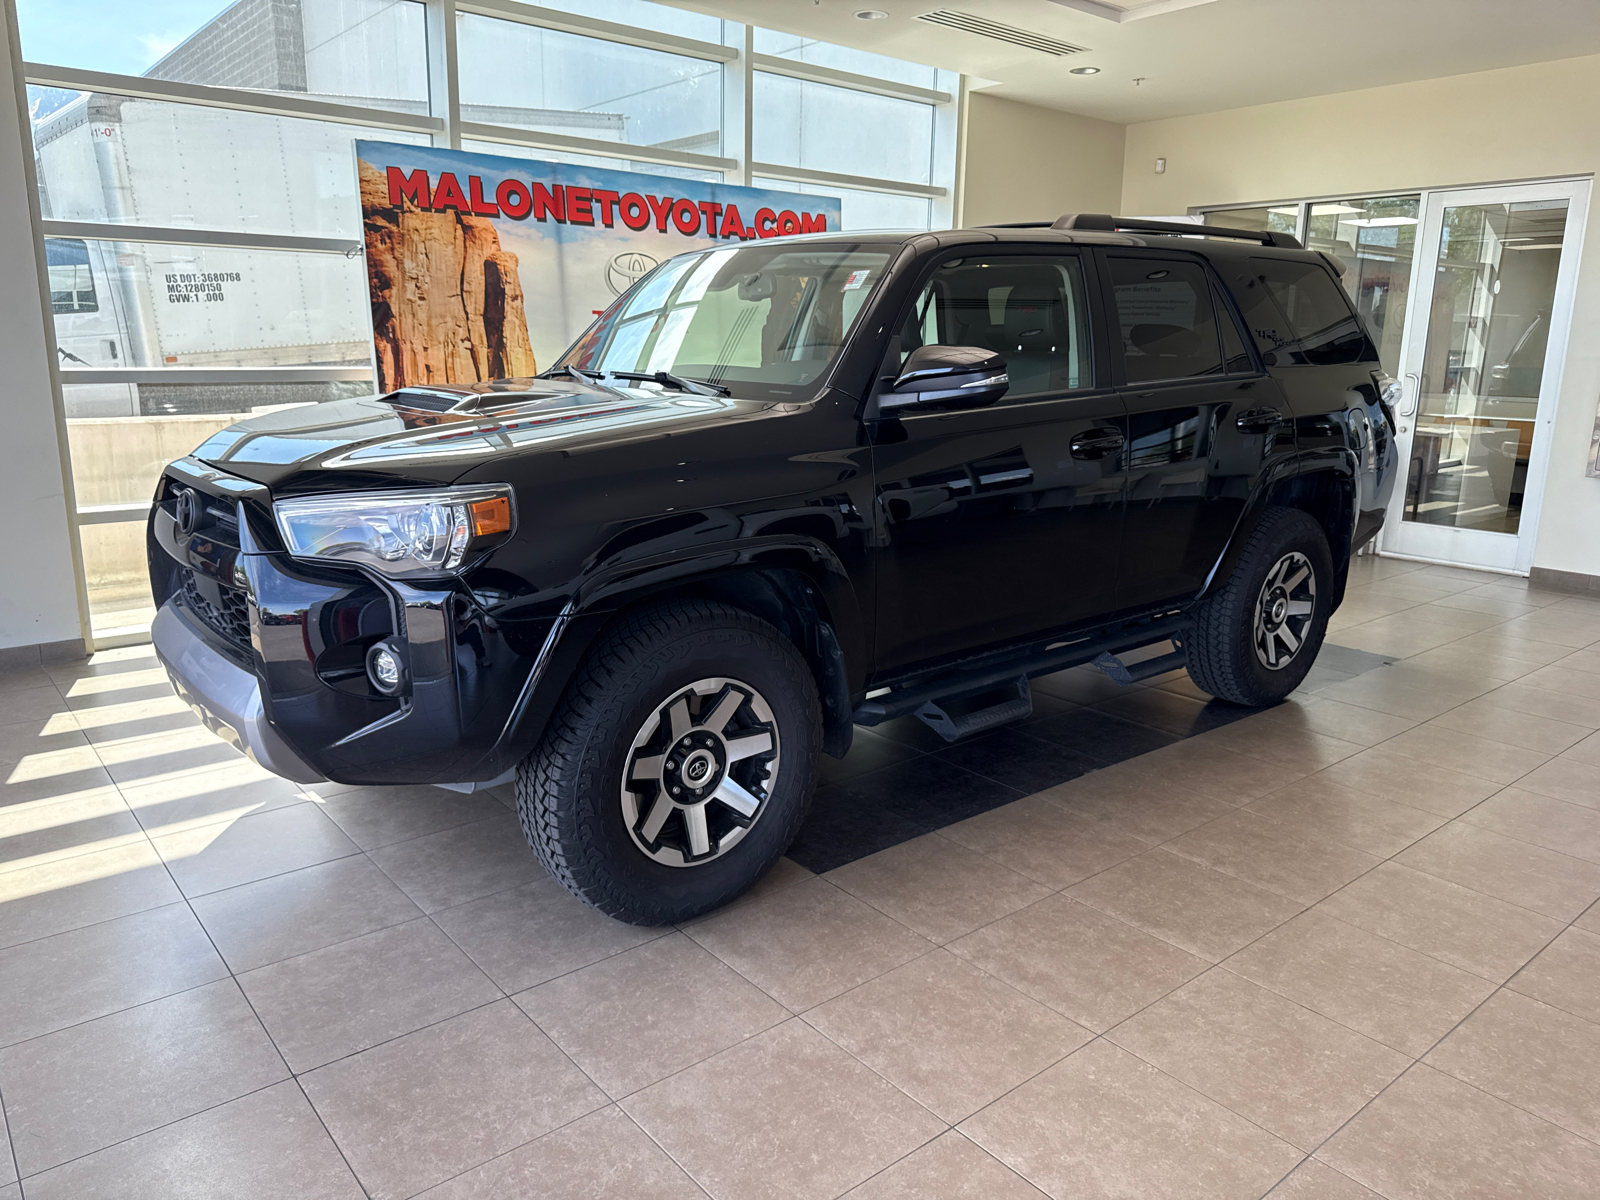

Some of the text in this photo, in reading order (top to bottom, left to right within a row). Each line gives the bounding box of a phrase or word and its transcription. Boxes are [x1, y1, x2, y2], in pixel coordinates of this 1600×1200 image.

[386, 166, 827, 240] MALONETOYOTA.COM
[165, 274, 178, 283] US
[201, 272, 241, 282] 3680768
[167, 283, 222, 293] MC:1280150
